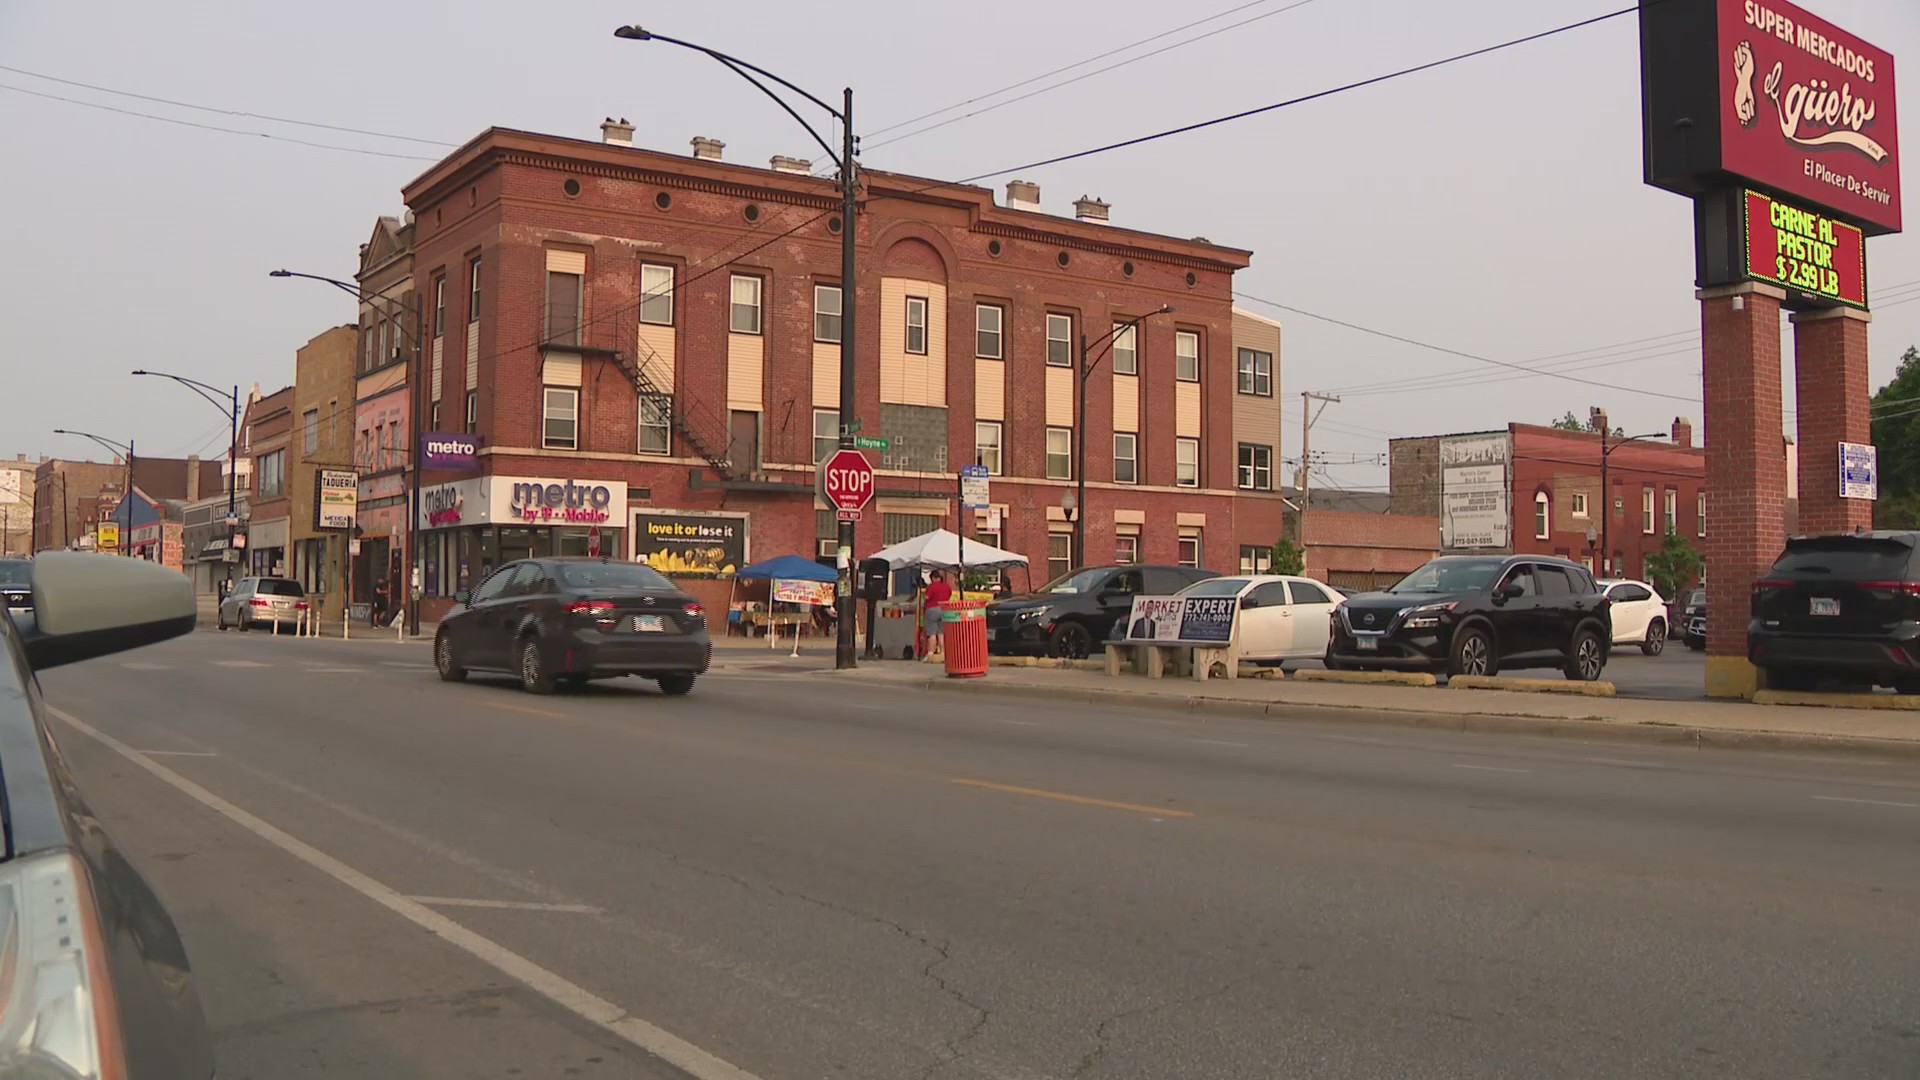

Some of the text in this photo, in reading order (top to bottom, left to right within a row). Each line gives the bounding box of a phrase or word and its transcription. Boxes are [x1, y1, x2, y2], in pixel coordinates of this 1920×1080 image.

[1744, 0, 1875, 83] SUPER MERCADOS
[1784, 79, 1876, 138] güero
[1804, 158, 1891, 205] El Placer De Servir
[1770, 201, 1838, 247] CARNE AL
[1777, 230, 1833, 268] PASTOR
[1789, 257, 1818, 290] 2.99
[1819, 268, 1839, 296] LB
[427, 440, 475, 456] metro
[861, 437, 880, 448] Hoyne
[323, 477, 356, 488] TAQUERIA
[512, 479, 610, 511] metro
[828, 469, 870, 493] STOP
[523, 504, 539, 524] by
[648, 522, 734, 537] love it or lose it
[1136, 599, 1235, 614] MRKET EXPERT
